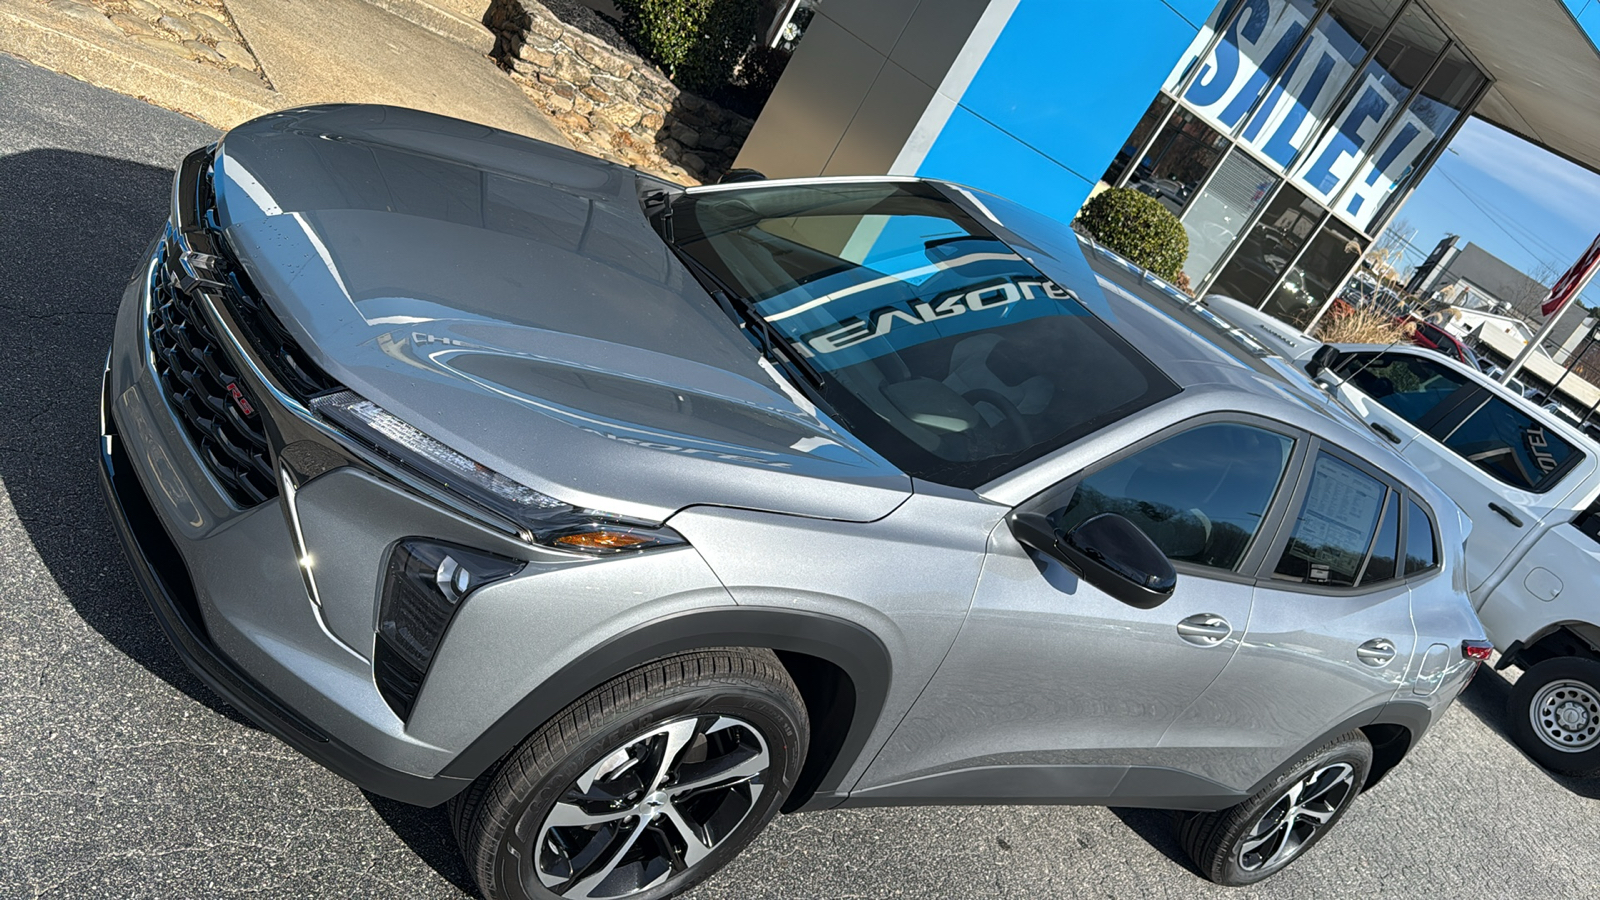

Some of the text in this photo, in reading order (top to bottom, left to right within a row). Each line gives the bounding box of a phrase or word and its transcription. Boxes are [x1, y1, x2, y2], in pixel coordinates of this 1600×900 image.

[1180, 0, 1421, 217] SALE!
[227, 384, 255, 415] RS
[529, 712, 654, 815] GOODYEAR
